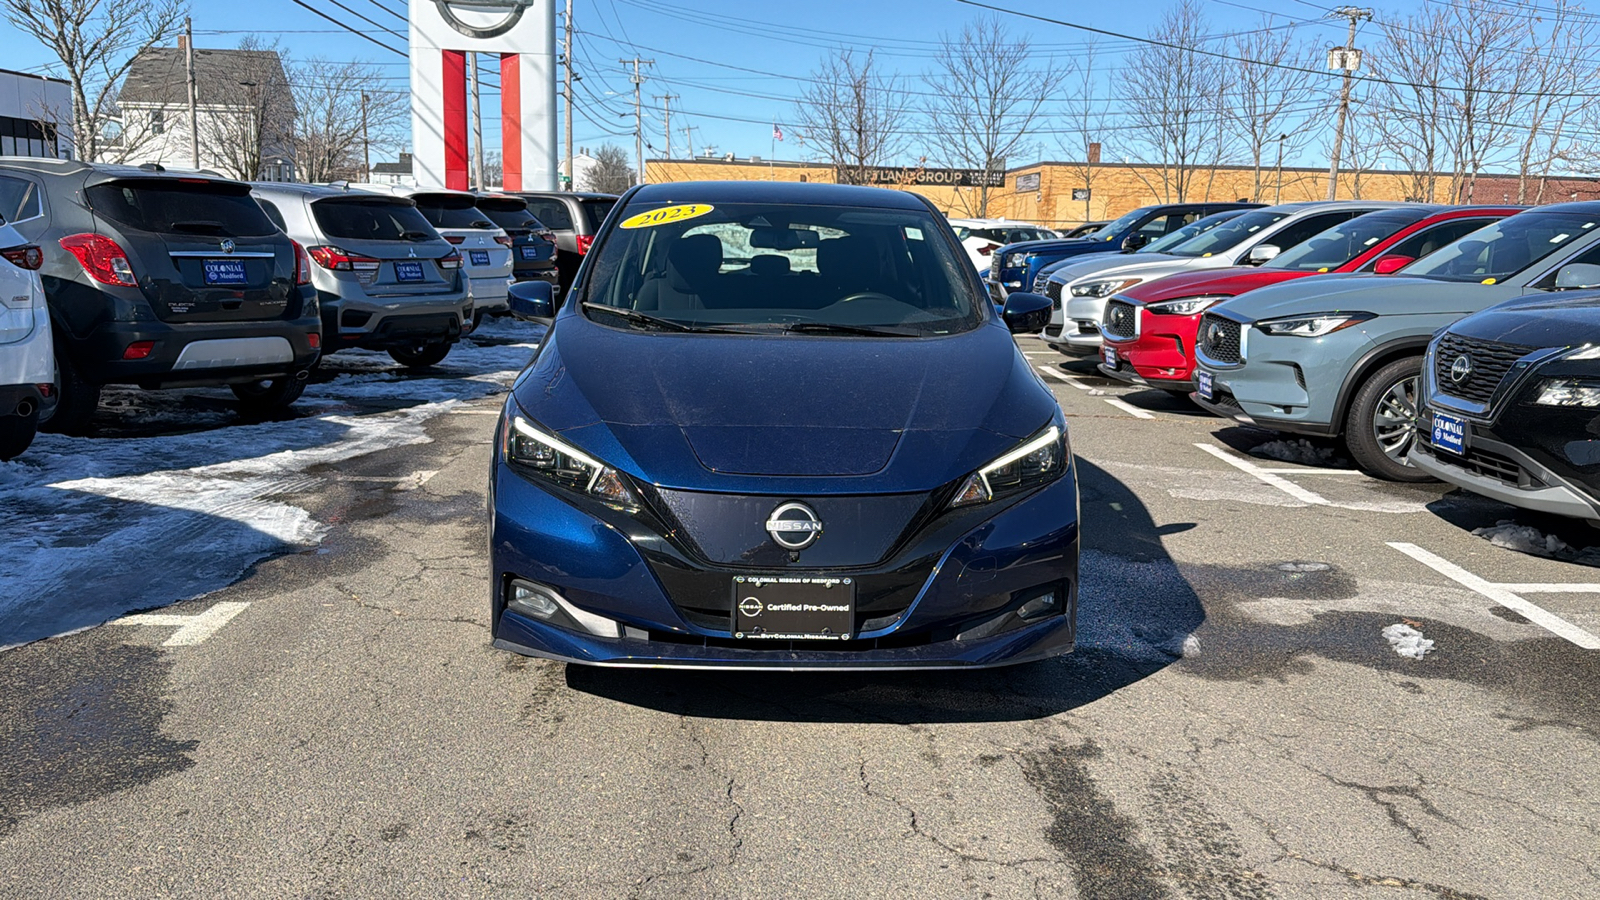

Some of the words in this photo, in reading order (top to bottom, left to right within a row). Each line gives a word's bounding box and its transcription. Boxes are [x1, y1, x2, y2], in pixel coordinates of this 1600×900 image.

[917, 170, 963, 183] GROUP
[638, 206, 696, 226] 2023
[205, 264, 244, 272] COLONIAL
[1434, 418, 1464, 436] COLONIAL
[1443, 432, 1462, 446] Medford
[767, 521, 822, 530] NISSAN
[767, 603, 802, 612] Certified
[803, 604, 849, 612] Pre-Owned
